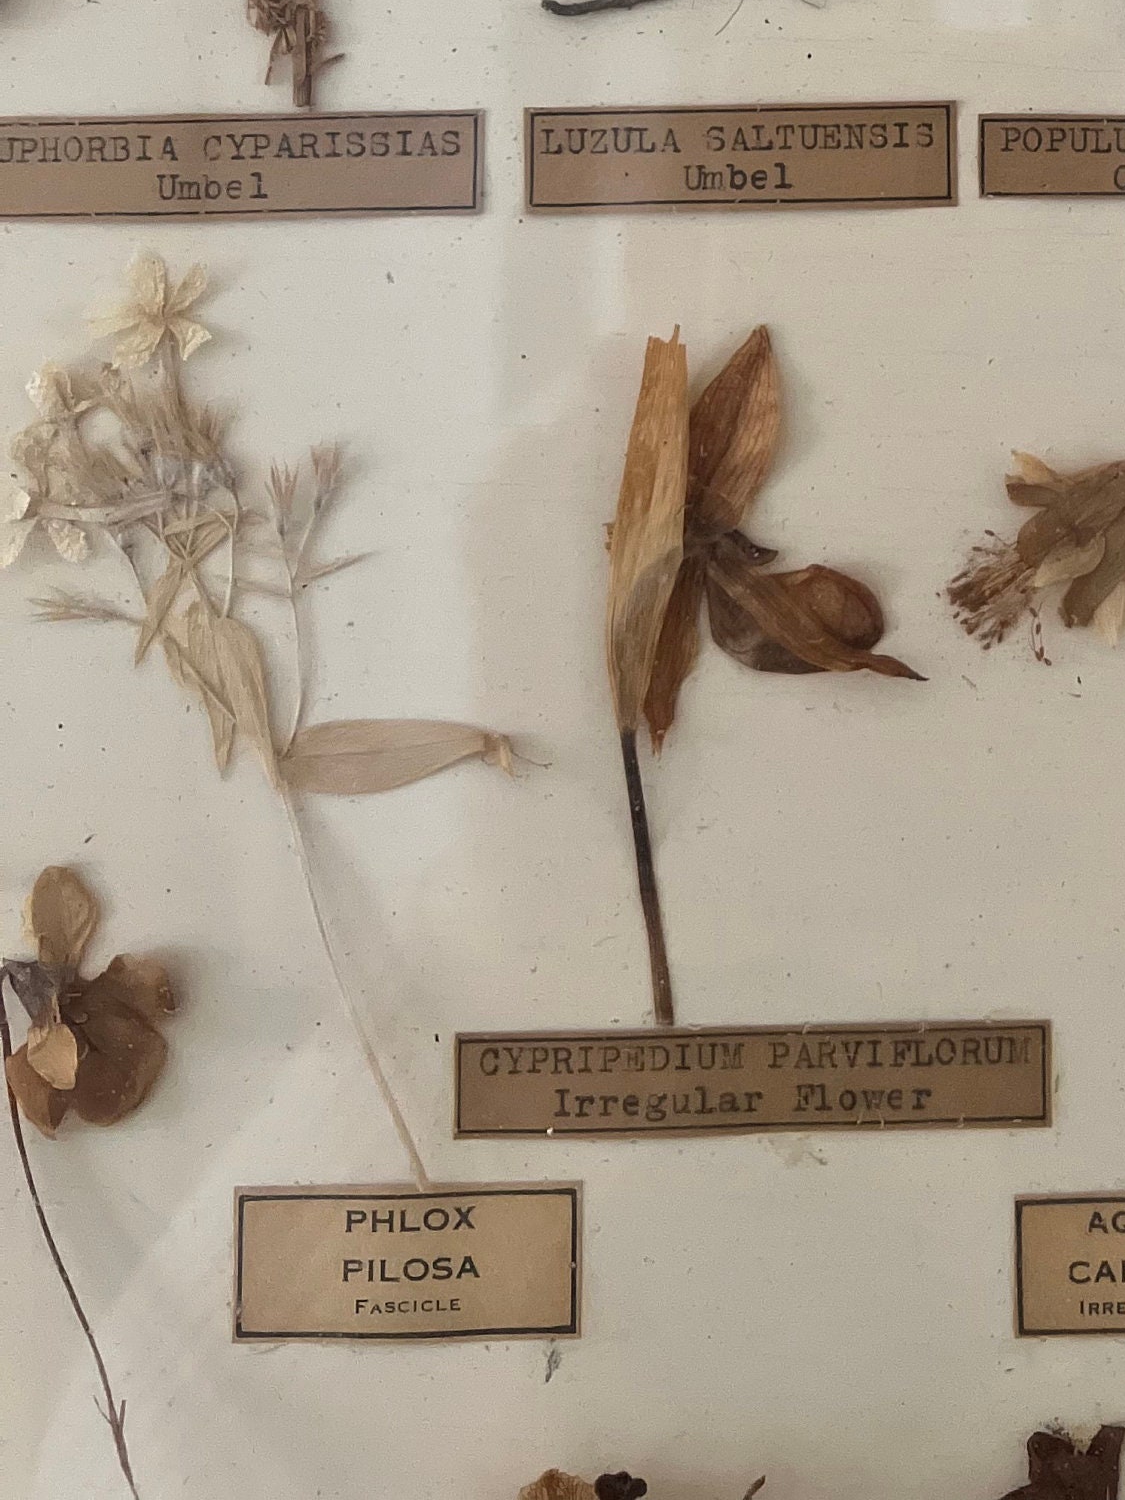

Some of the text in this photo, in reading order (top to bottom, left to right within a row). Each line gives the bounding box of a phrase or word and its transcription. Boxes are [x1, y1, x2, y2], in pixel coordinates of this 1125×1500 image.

[203, 129, 462, 161] CYPARISSIAS
[540, 122, 935, 155] LUZULA SALTUENSIS
[157, 173, 269, 200] Umbel
[684, 163, 794, 191] Umbel
[478, 1037, 1031, 1076] CYPRIPEDIUM PARVIFLORUM
[553, 1082, 933, 1121] Irregular Flower
[345, 1206, 477, 1233] PHLOX
[342, 1256, 481, 1283] PILOSA
